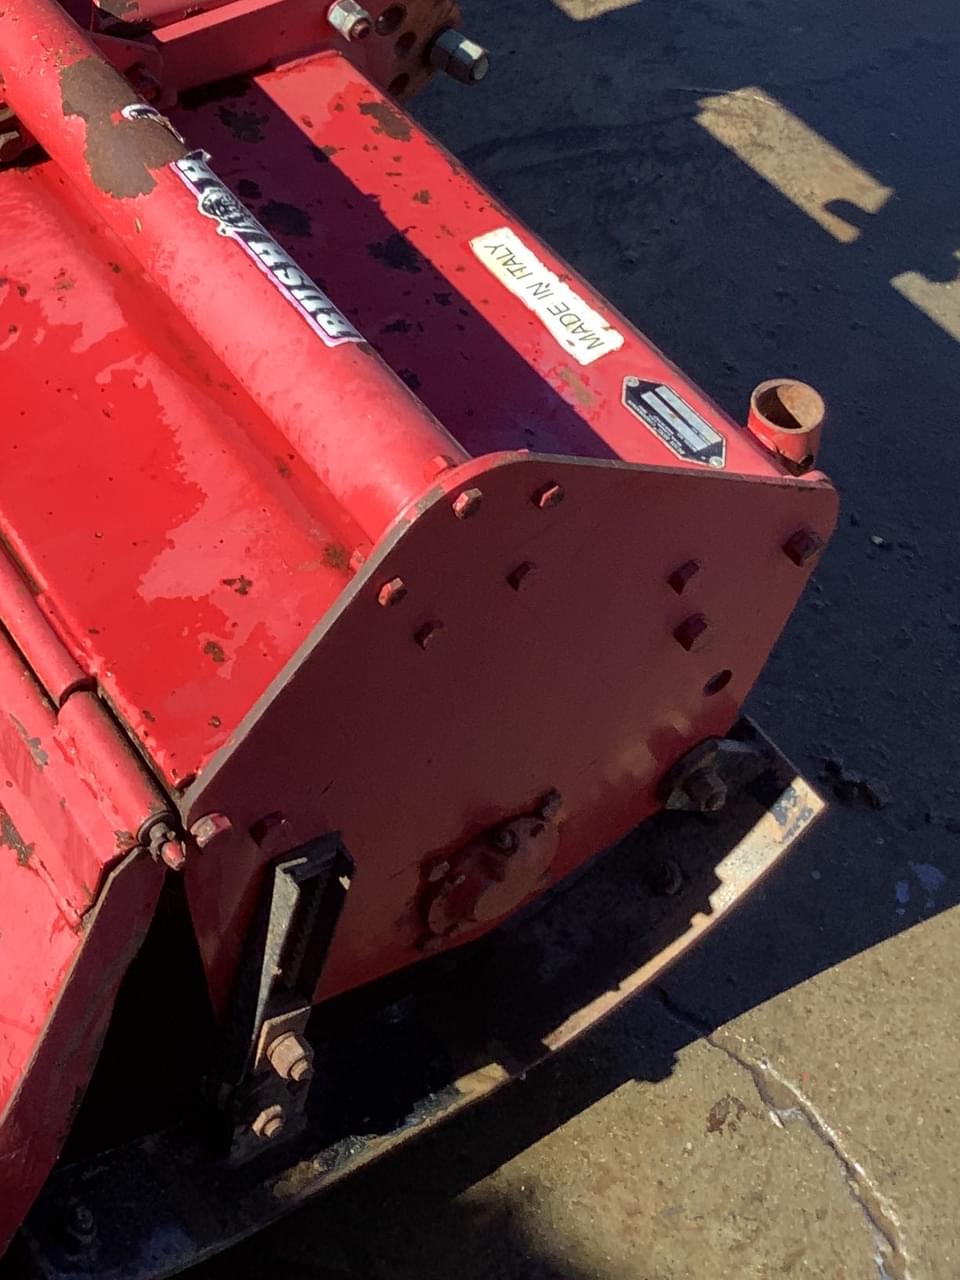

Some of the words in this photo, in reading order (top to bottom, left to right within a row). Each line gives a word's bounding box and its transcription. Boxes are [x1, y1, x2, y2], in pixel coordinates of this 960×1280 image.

[484, 243, 533, 280] ITALY
[247, 241, 362, 339] BUSH
[526, 281, 554, 300] IN
[546, 302, 605, 350] MADE
